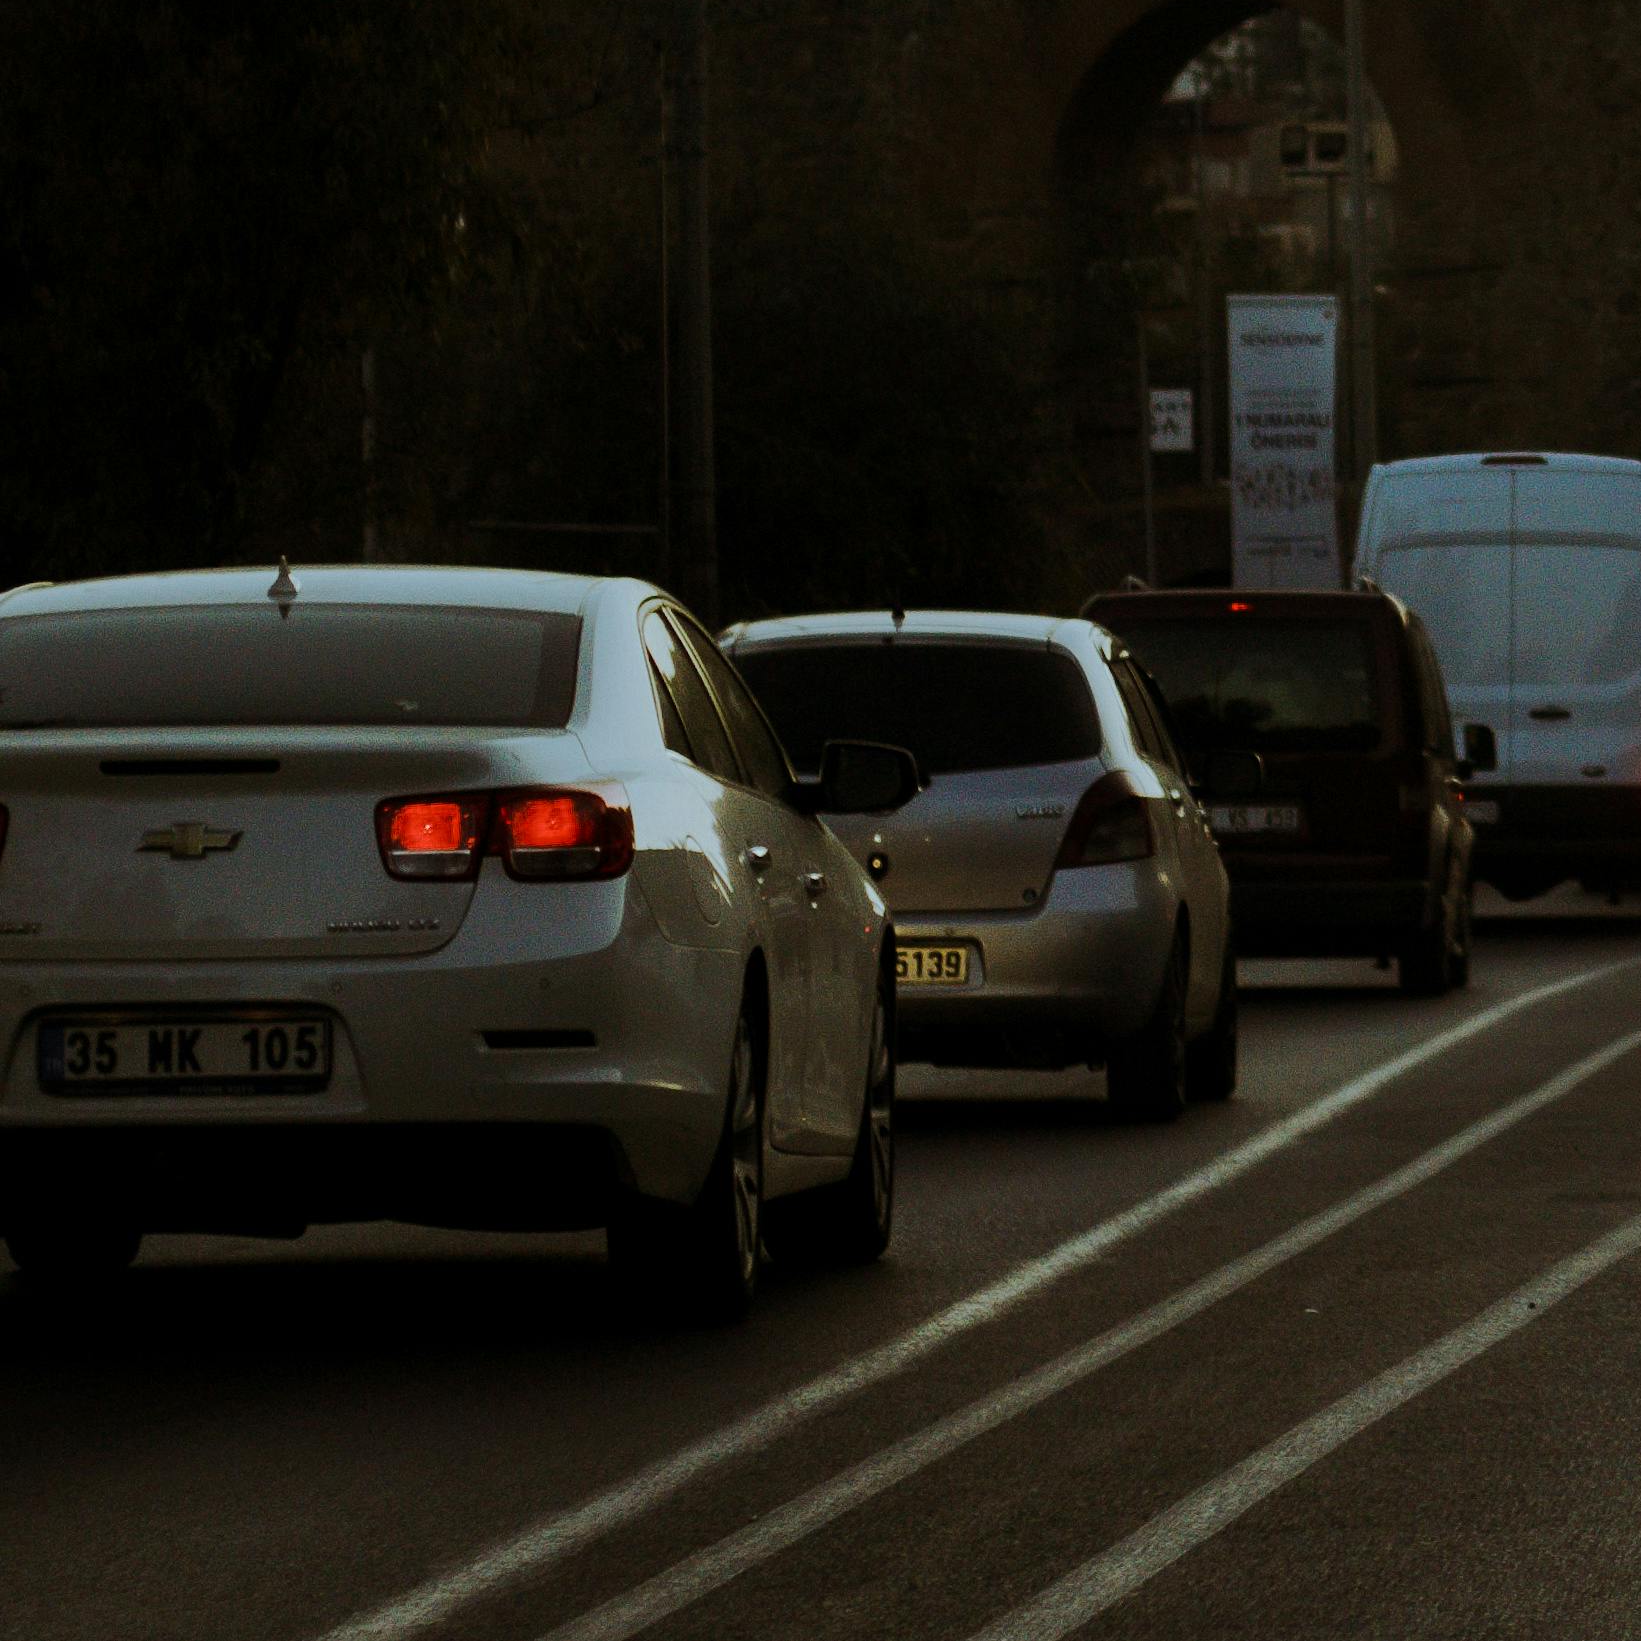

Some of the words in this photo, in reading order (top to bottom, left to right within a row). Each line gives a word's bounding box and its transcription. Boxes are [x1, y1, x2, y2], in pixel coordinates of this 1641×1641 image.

[66, 1030, 118, 1075] 35
[147, 1028, 202, 1073] MK
[241, 1024, 318, 1071] 105
